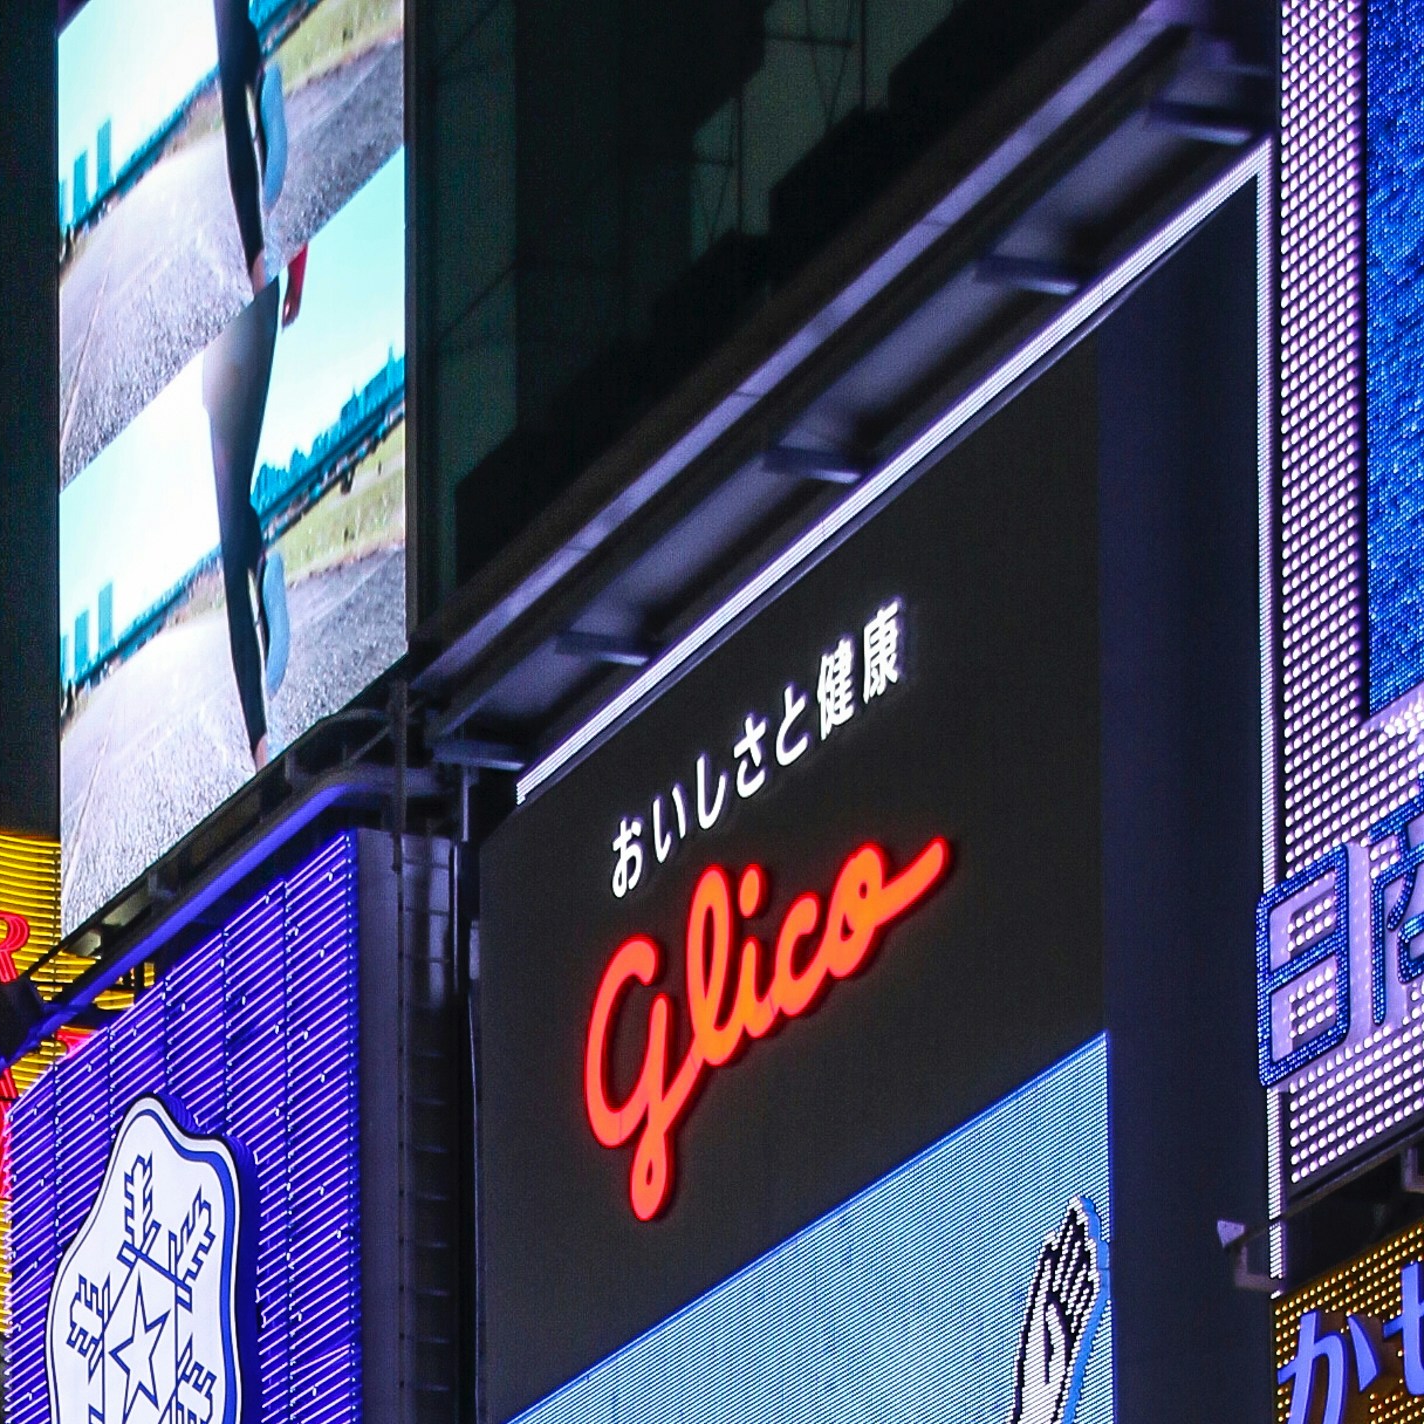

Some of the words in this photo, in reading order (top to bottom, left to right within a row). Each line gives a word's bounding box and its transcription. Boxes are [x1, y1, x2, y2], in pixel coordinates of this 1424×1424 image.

[611, 598, 901, 898] おいしさと健康
[584, 838, 950, 1222] Glico
